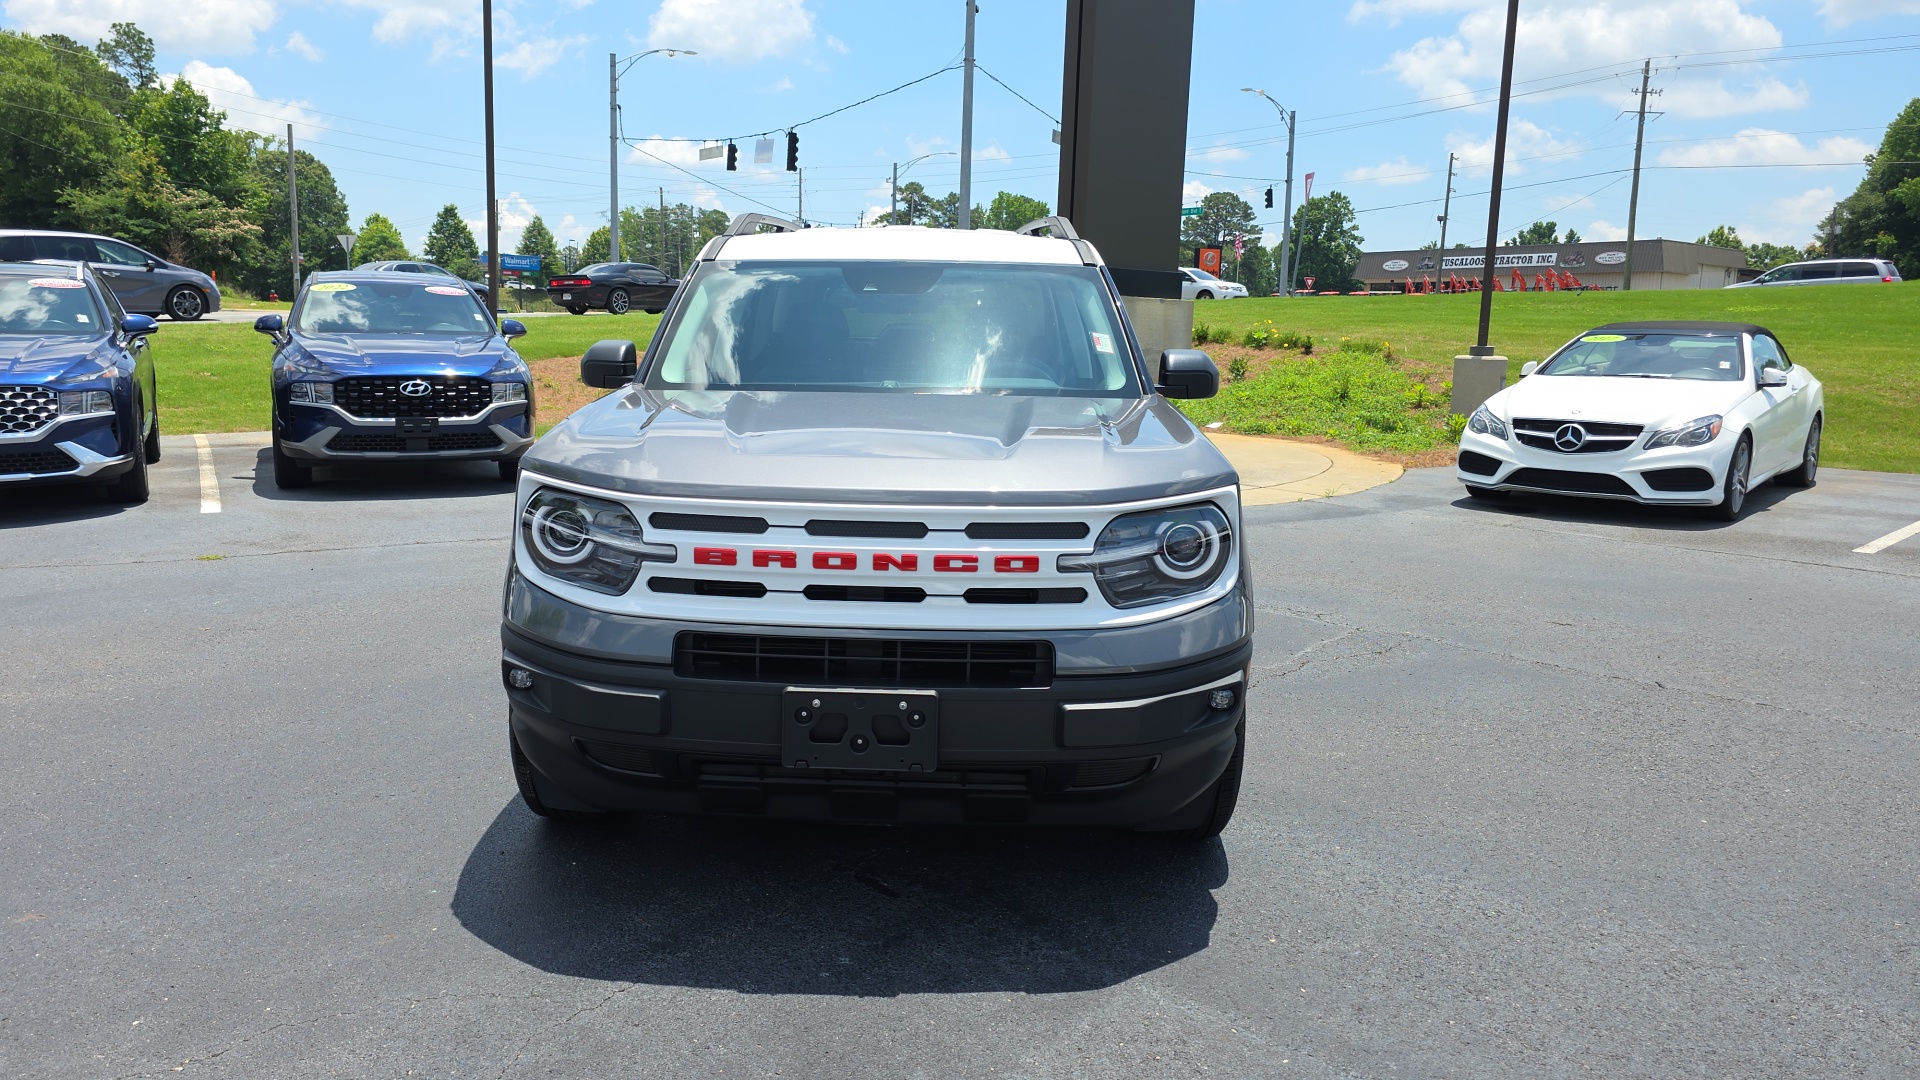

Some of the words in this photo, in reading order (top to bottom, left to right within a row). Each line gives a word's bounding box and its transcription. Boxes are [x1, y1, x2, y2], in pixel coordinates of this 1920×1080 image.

[504, 256, 530, 265] Walmart
[1442, 257, 1485, 267] USCALOOS
[1494, 255, 1533, 265] TRACTOR
[1536, 254, 1554, 264] INC.
[694, 547, 1039, 572] BRONCO
